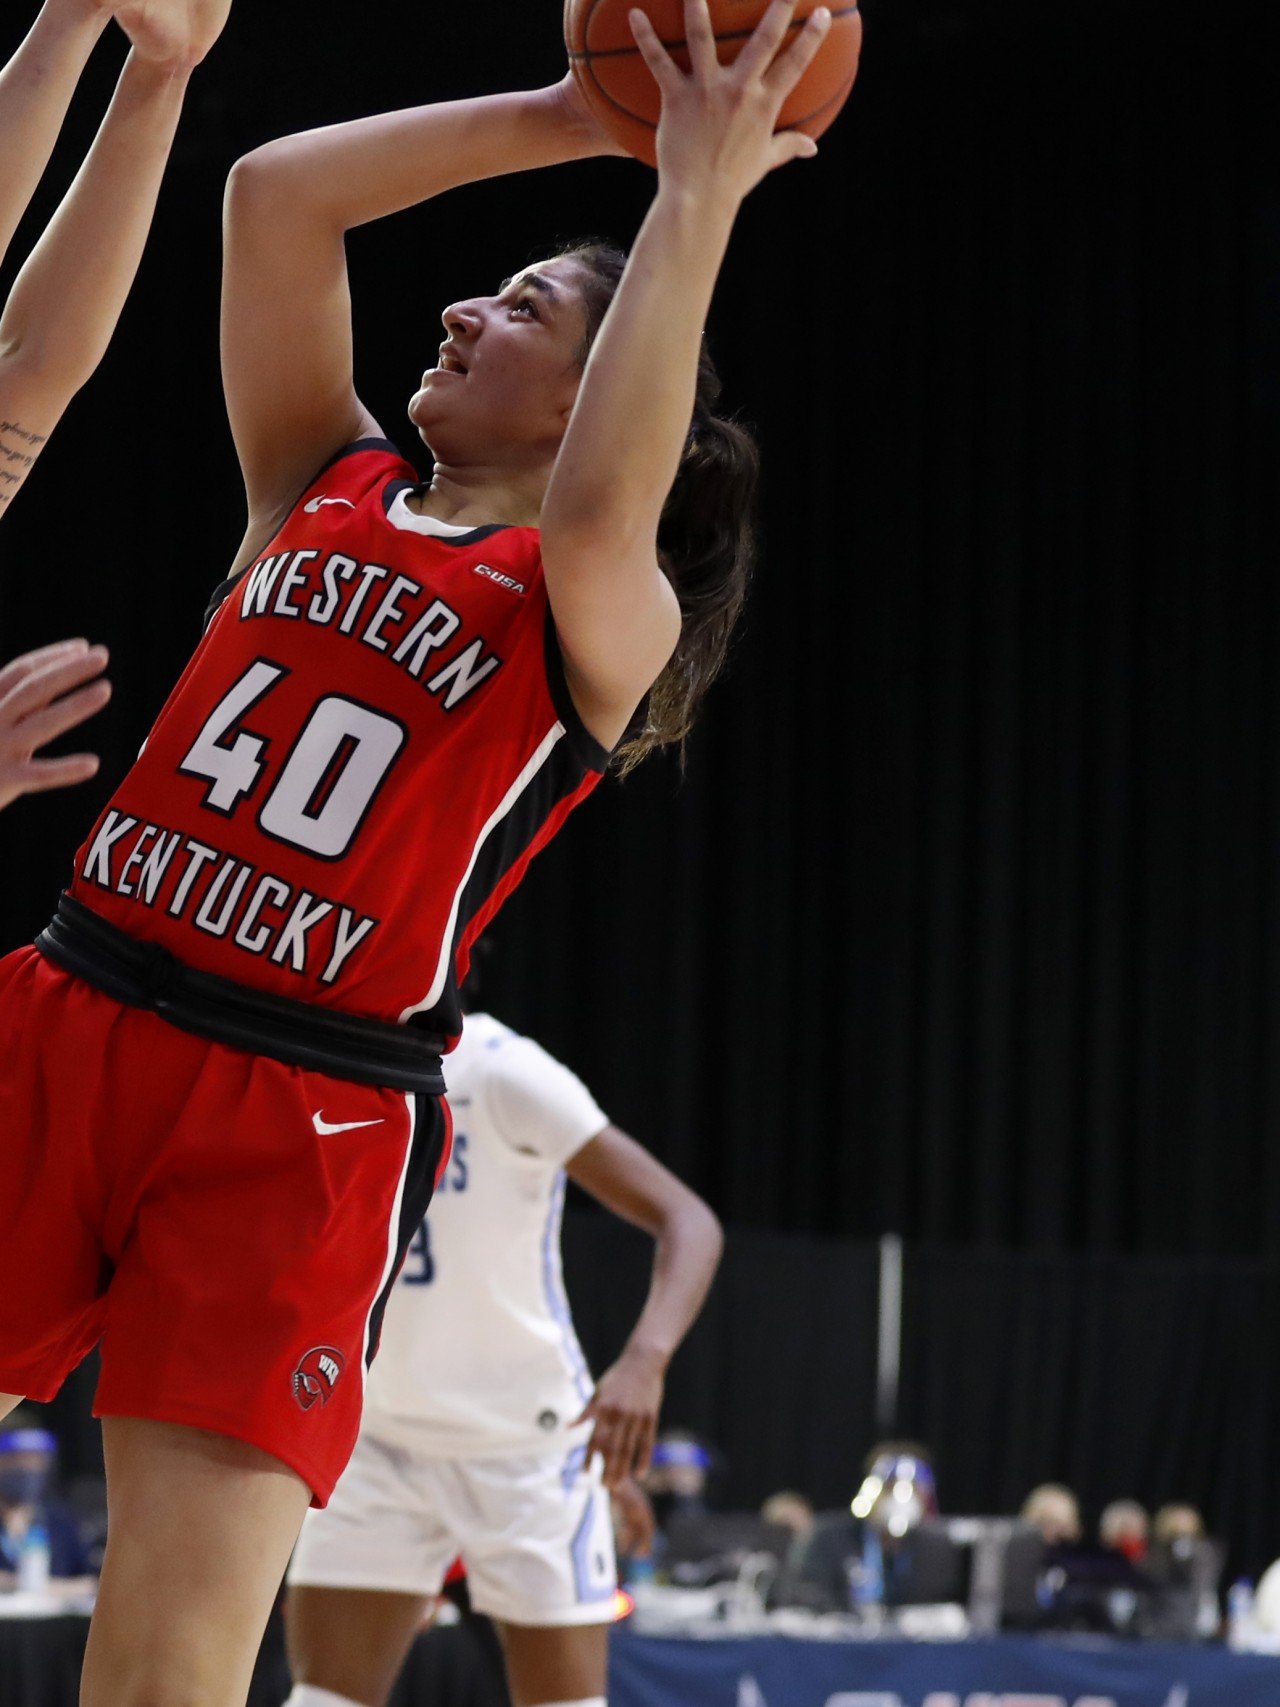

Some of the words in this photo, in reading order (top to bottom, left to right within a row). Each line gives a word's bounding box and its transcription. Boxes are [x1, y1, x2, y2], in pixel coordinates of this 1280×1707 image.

[239, 548, 504, 712] WESTERN
[176, 655, 410, 863] 40
[79, 808, 382, 985] KENTUCKY
